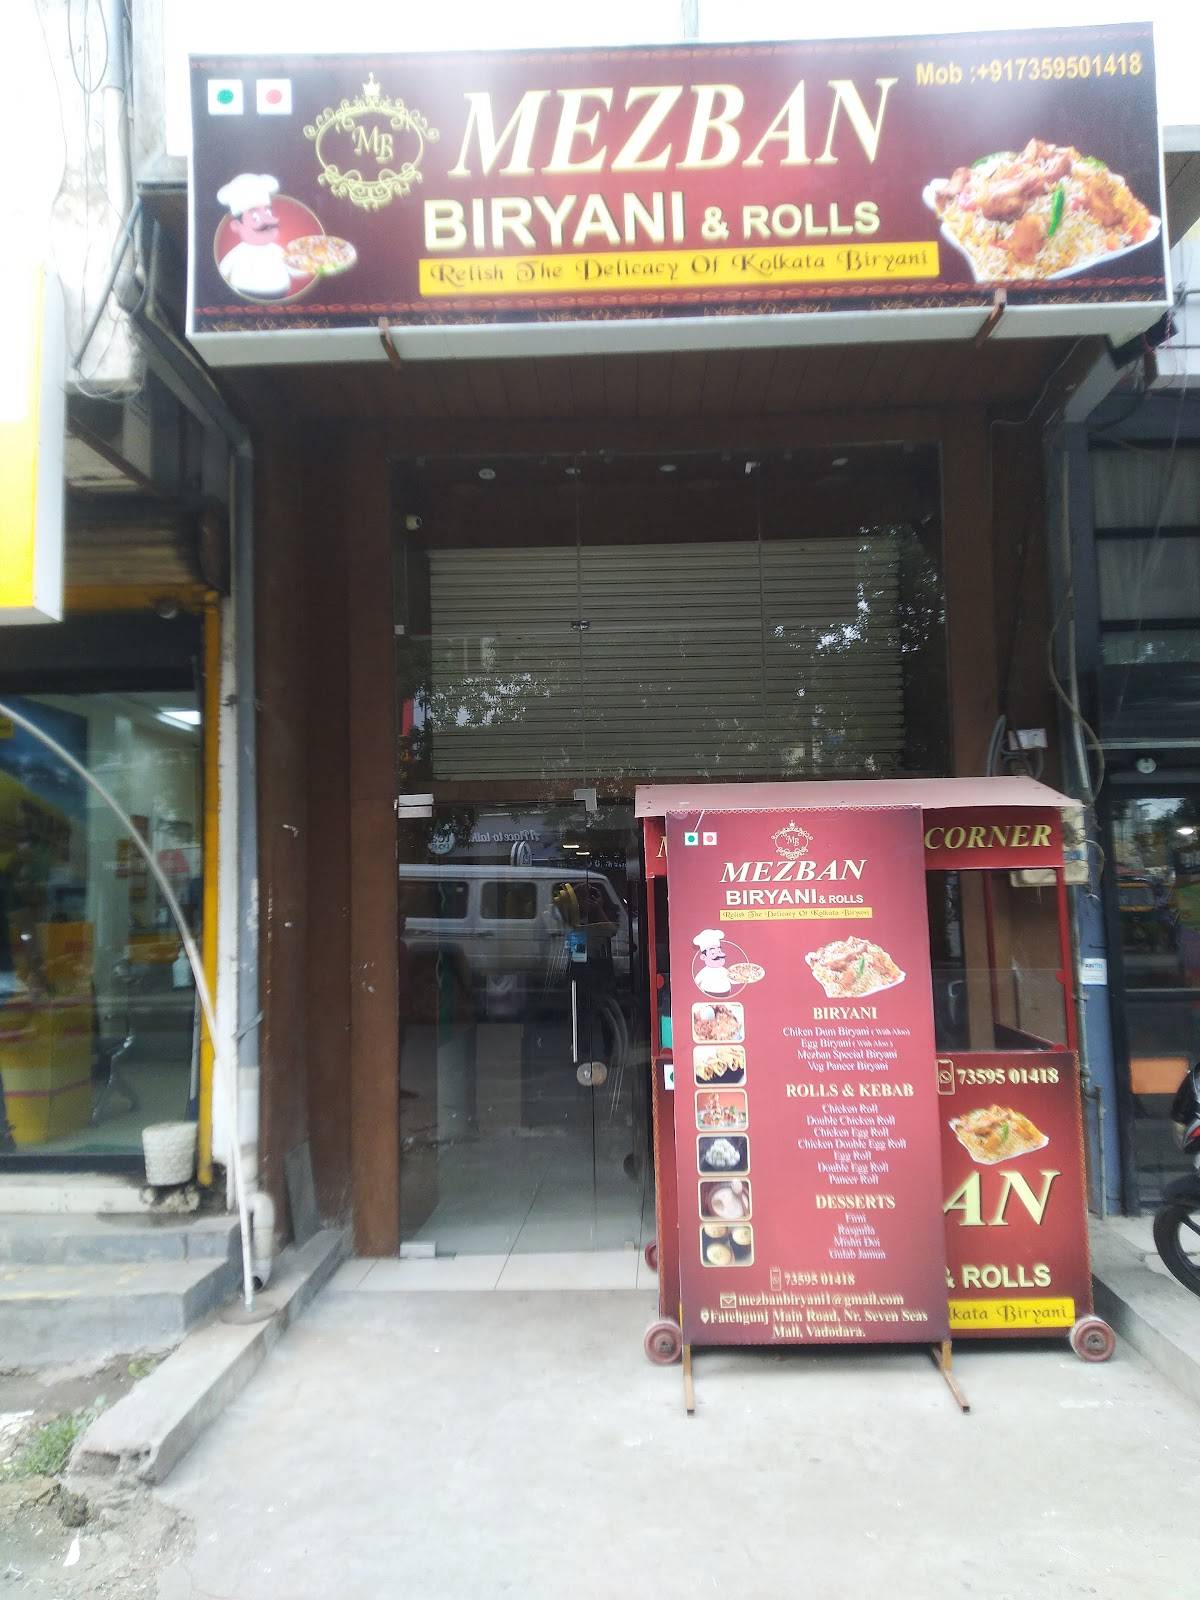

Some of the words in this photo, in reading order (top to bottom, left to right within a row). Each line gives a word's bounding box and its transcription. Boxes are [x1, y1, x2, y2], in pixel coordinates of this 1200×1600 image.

[915, 61, 963, 87] Mob
[448, 78, 898, 177] MEZBAN
[423, 191, 685, 251] BIRYANI
[701, 206, 729, 240] &
[742, 200, 881, 239] ROLLS
[430, 264, 504, 288] Relish
[516, 260, 562, 282] The
[575, 258, 680, 283] Delicacy
[691, 254, 718, 274] Of
[732, 252, 825, 277] Kolkata
[837, 249, 928, 273] Biryani
[924, 824, 1053, 850] CORNER
[719, 859, 868, 883] MEZBAN
[726, 889, 816, 905] BIRYANI
[818, 895, 826, 904] &
[829, 894, 864, 904] ROLLS
[813, 1007, 878, 1020] BIRYANI
[815, 1026, 837, 1037] Dum
[838, 1026, 870, 1038] Biryani
[800, 1038, 818, 1049] Egg
[820, 1038, 852, 1049] Biryani
[797, 1050, 831, 1060] Mezban
[832, 1050, 864, 1061] Special
[865, 1049, 898, 1061] Biryani
[808, 1061, 825, 1072] Veg
[826, 1061, 855, 1071] Paneer
[857, 1060, 889, 1072] Biryani
[956, 1068, 1006, 1085] 73595
[1008, 1067, 1060, 1084] 01418
[786, 1083, 839, 1097] ROLLS
[842, 1083, 855, 1097] &
[859, 1083, 914, 1097] KEBAB
[822, 1104, 858, 1114] Chicken
[859, 1103, 878, 1113] Roll
[806, 1115, 838, 1126] Double
[839, 1115, 875, 1126] Chicken
[876, 1115, 896, 1125] Roll
[813, 1127, 850, 1137] Chicken
[851, 1127, 869, 1139] Egg
[870, 1126, 889, 1137] Roll
[797, 1138, 834, 1149] Chicken
[835, 1138, 867, 1149] Double
[868, 1138, 887, 1151] Egg
[887, 1138, 907, 1149] Roll
[833, 1150, 852, 1162] Egg
[853, 1150, 872, 1160] Roll
[817, 1162, 849, 1173] Double
[851, 1162, 869, 1174] Egg
[870, 1162, 889, 1172] Roll
[828, 1174, 859, 1184] Paneer
[859, 1173, 879, 1184] Roll
[815, 1194, 896, 1209] DESSERTS
[784, 1272, 818, 1286] 73595
[820, 1272, 856, 1286] 01418
[961, 1263, 1052, 1289] ROLLS
[710, 1309, 769, 1325] Fatehgunj
[772, 1309, 803, 1322] Main
[843, 1309, 862, 1322] Nr.
[864, 1308, 899, 1321] Seven
[901, 1308, 928, 1321] Seas
[997, 1304, 1067, 1323] Biryani
[806, 1324, 866, 1338] Vadodara.
